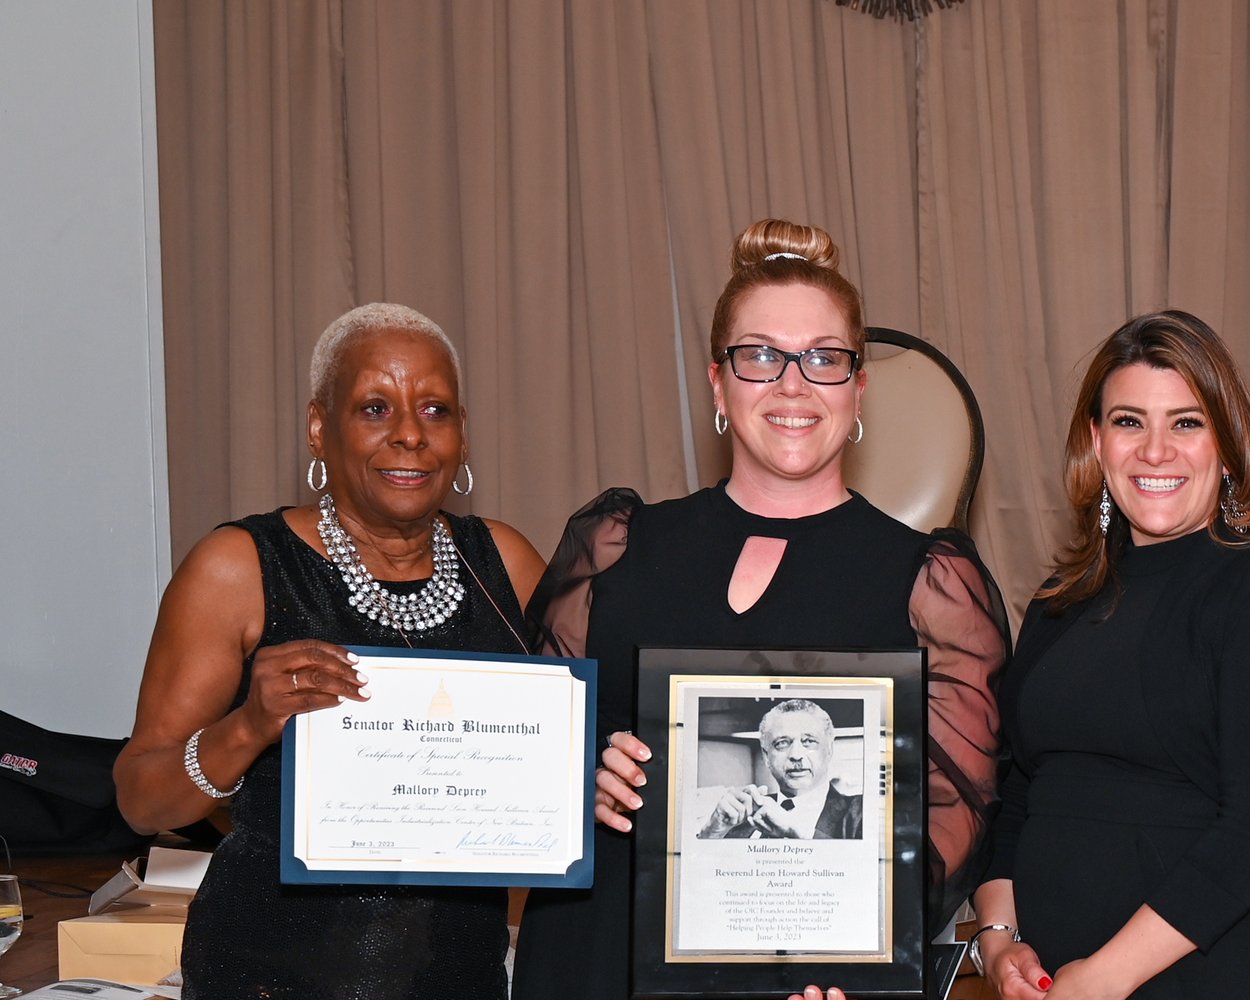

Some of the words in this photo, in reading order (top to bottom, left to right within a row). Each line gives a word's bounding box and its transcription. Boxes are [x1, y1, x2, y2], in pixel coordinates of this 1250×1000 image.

[342, 715, 394, 731] Senator
[402, 718, 455, 733] Richard
[462, 720, 540, 736] Blumenthal
[420, 735, 462, 743] Connecticut
[354, 747, 404, 762] Certificate
[406, 749, 420, 762] of
[421, 747, 463, 763] Special
[464, 749, 523, 763] Recognition
[392, 784, 439, 798] Mallory
[446, 785, 487, 799] Deprey
[351, 840, 366, 848] June
[747, 845, 780, 855] Mallory
[783, 845, 814, 855] Deprey
[762, 858, 793, 866] presented
[715, 869, 754, 877] Reverend
[756, 869, 776, 877] Leon
[778, 869, 810, 877] Howard
[812, 869, 845, 877] Sullivan
[767, 880, 793, 888] Award
[756, 933, 773, 941] June
